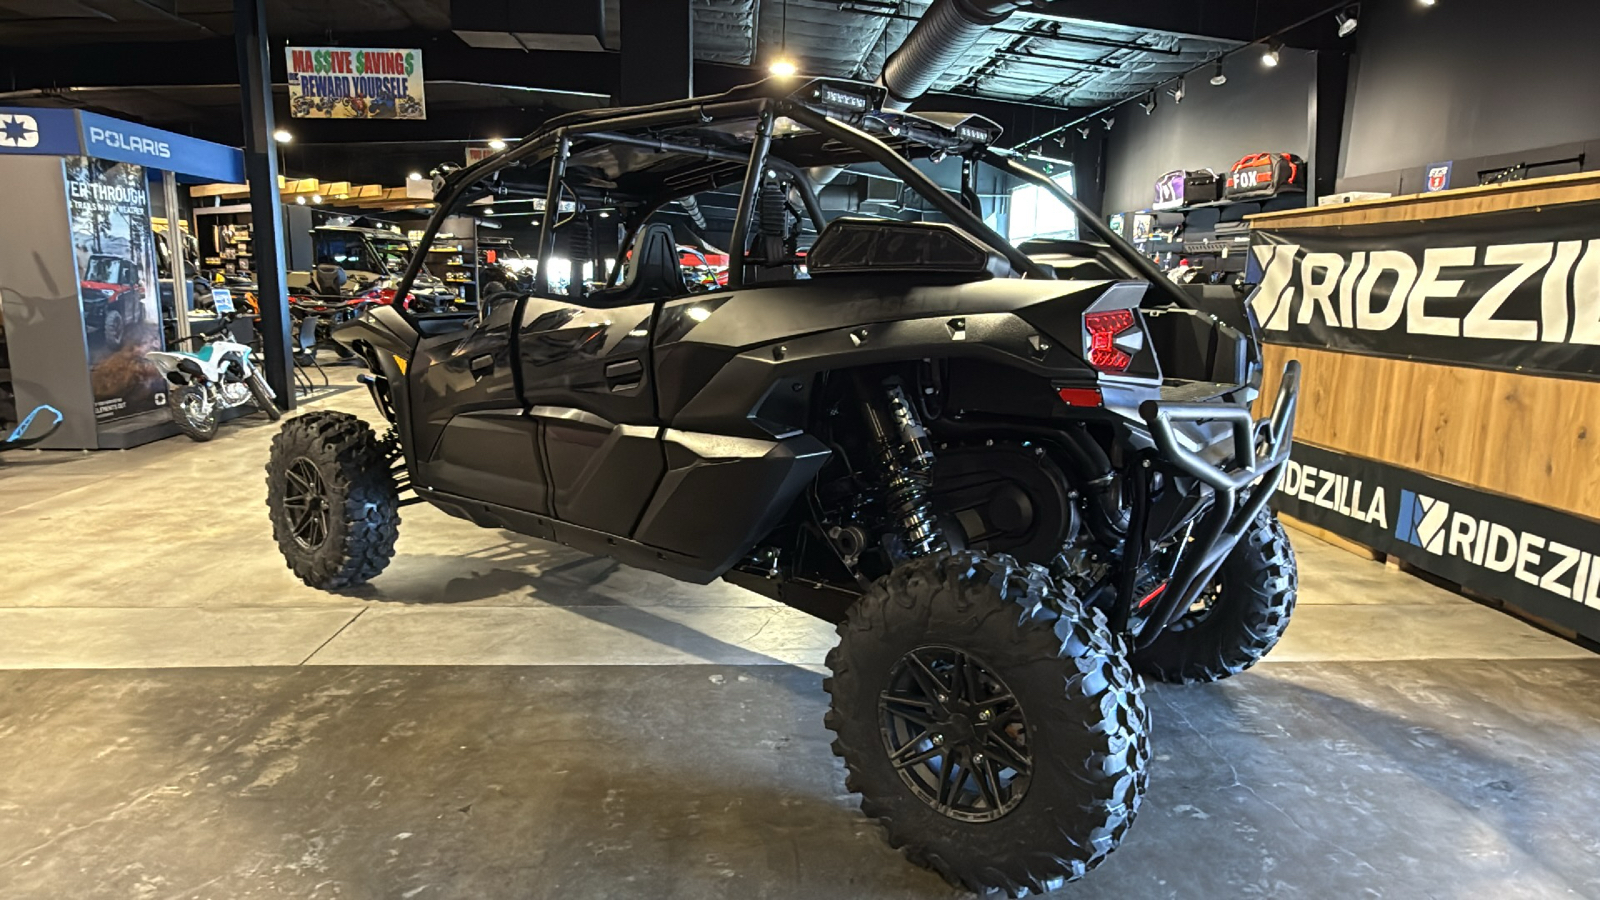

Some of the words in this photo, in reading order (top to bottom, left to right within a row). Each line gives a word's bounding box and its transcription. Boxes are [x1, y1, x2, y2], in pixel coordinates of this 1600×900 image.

[301, 75, 350, 97] REWARD
[353, 76, 408, 98] YOURSELF
[90, 127, 170, 158] POLARIS
[1233, 171, 1257, 189] FOX
[91, 183, 146, 205] THROUGH
[1254, 460, 1388, 529] DEZILLA
